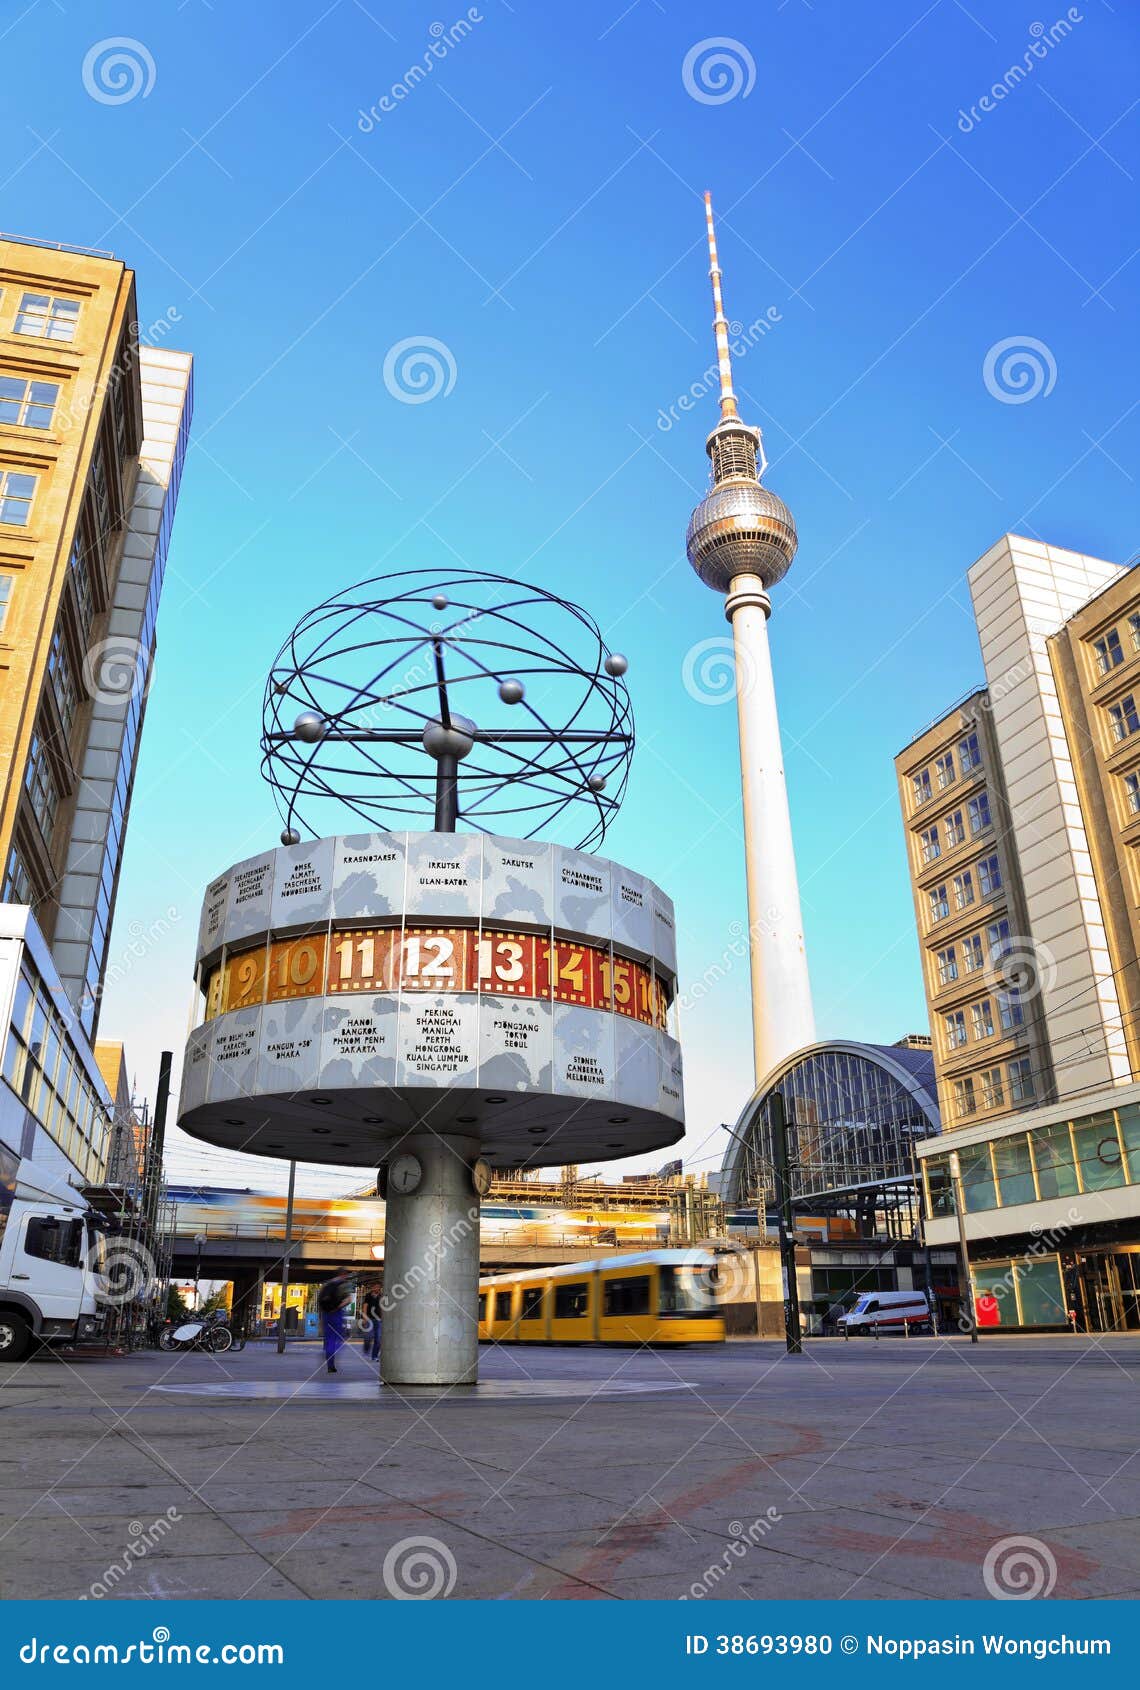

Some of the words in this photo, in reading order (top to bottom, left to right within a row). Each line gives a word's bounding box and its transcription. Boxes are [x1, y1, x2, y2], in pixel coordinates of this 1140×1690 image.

[344, 853, 396, 864] KRASNOJARSK
[294, 862, 311, 871] OMSK
[429, 861, 461, 869] IRKUTSK
[501, 858, 534, 869] JAKUTSK
[291, 870, 315, 880] ALMATY
[285, 877, 320, 889] TASCHKENT
[420, 878, 468, 886] ULAN-BATOR
[281, 884, 322, 897] NOWOSIBIRSK
[238, 959, 258, 1000] 9
[277, 945, 318, 988] 10
[335, 939, 375, 980] 11
[403, 936, 455, 977] 12
[474, 940, 524, 982] 13
[542, 948, 584, 991] 14
[600, 961, 631, 1004] 15
[425, 1009, 454, 1017] PEKING
[347, 1018, 373, 1026] HANOI
[416, 1018, 461, 1026] SHANGHAI
[341, 1027, 377, 1036] BANGKOK
[422, 1027, 455, 1035] MANILA
[505, 1031, 527, 1040] TOKYO
[333, 1037, 361, 1045] PHNOM
[364, 1036, 385, 1044] PENH
[426, 1036, 451, 1044] PERTH
[504, 1040, 528, 1049] SEOUL
[340, 1045, 377, 1054] JAKARTA
[415, 1045, 461, 1053] HONGKONG
[276, 1050, 300, 1059] DHAKA
[406, 1054, 433, 1062] KUALA
[437, 1054, 469, 1063] LUMPUR
[574, 1056, 597, 1066] SYDNEY
[416, 1063, 458, 1071] SINGAPUR
[567, 1064, 604, 1076] CANBERRA
[566, 1072, 605, 1085] MELBOURNE
